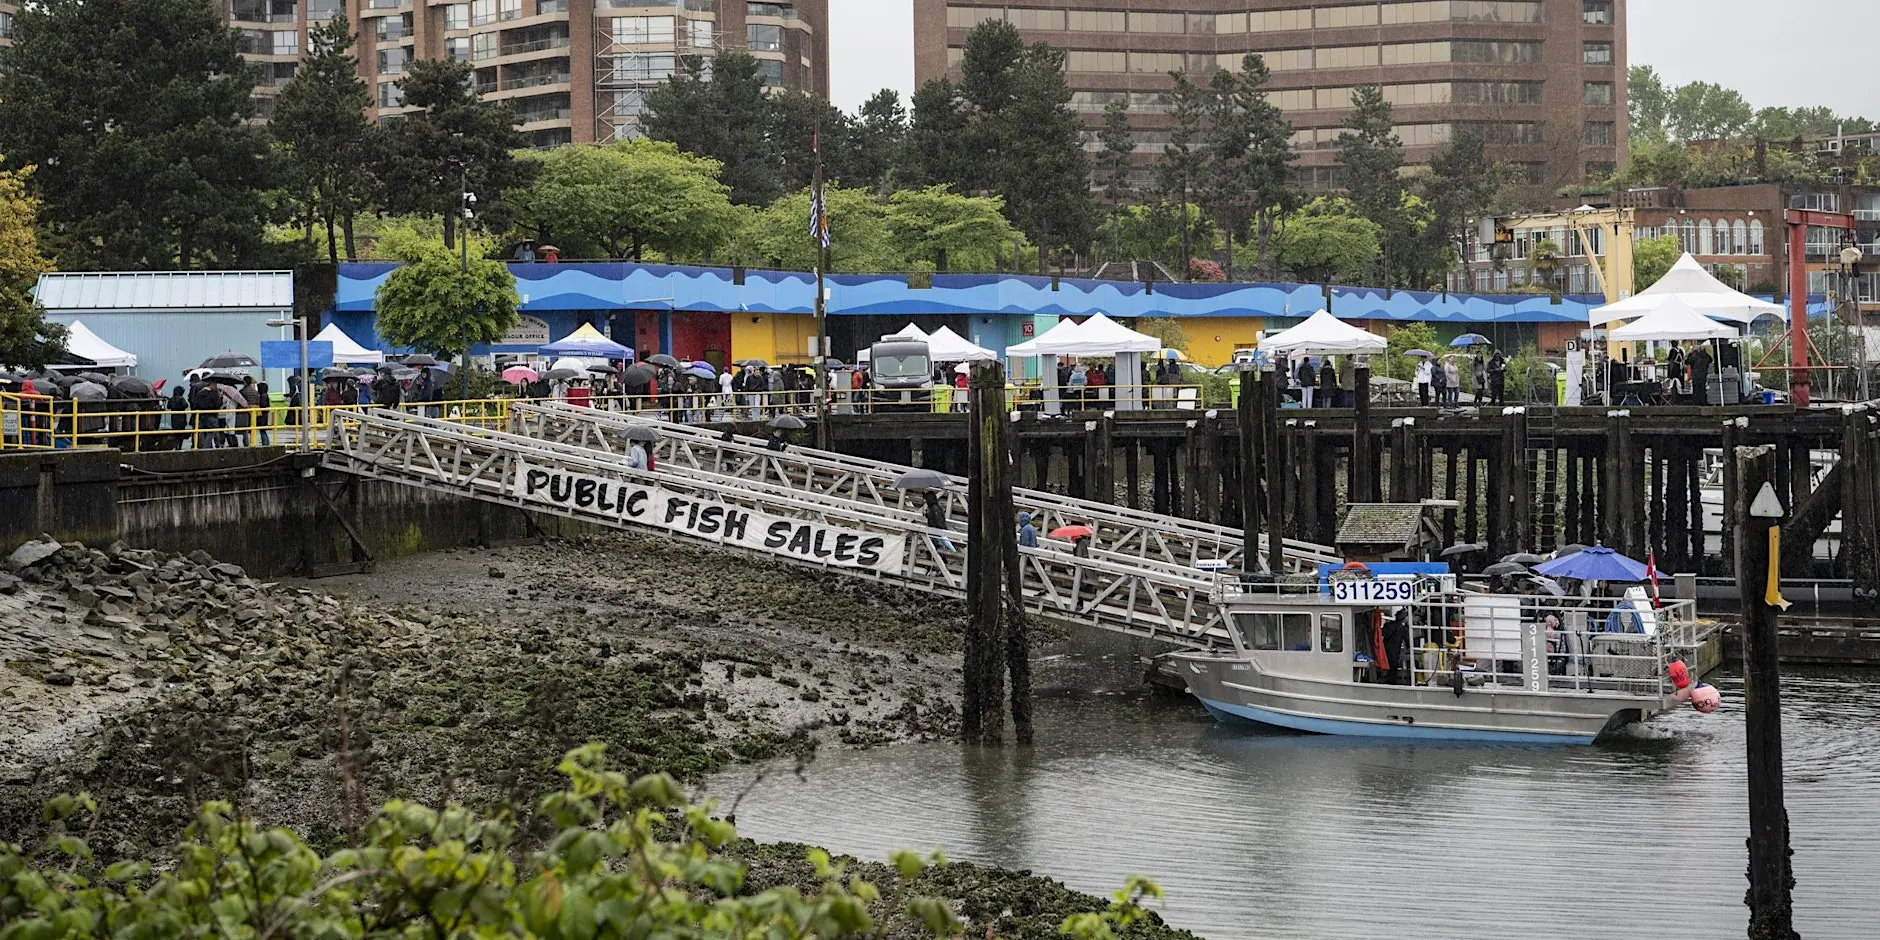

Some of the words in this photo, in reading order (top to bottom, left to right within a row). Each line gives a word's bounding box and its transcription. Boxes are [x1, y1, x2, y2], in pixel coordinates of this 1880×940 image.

[1024, 324, 1033, 332] 10
[1567, 341, 1575, 350] D
[526, 469, 648, 516] PUBLIC
[665, 497, 749, 540] FISH
[764, 521, 883, 566] SALES
[1336, 582, 1411, 600] 311259
[1529, 624, 1540, 692] 311259
